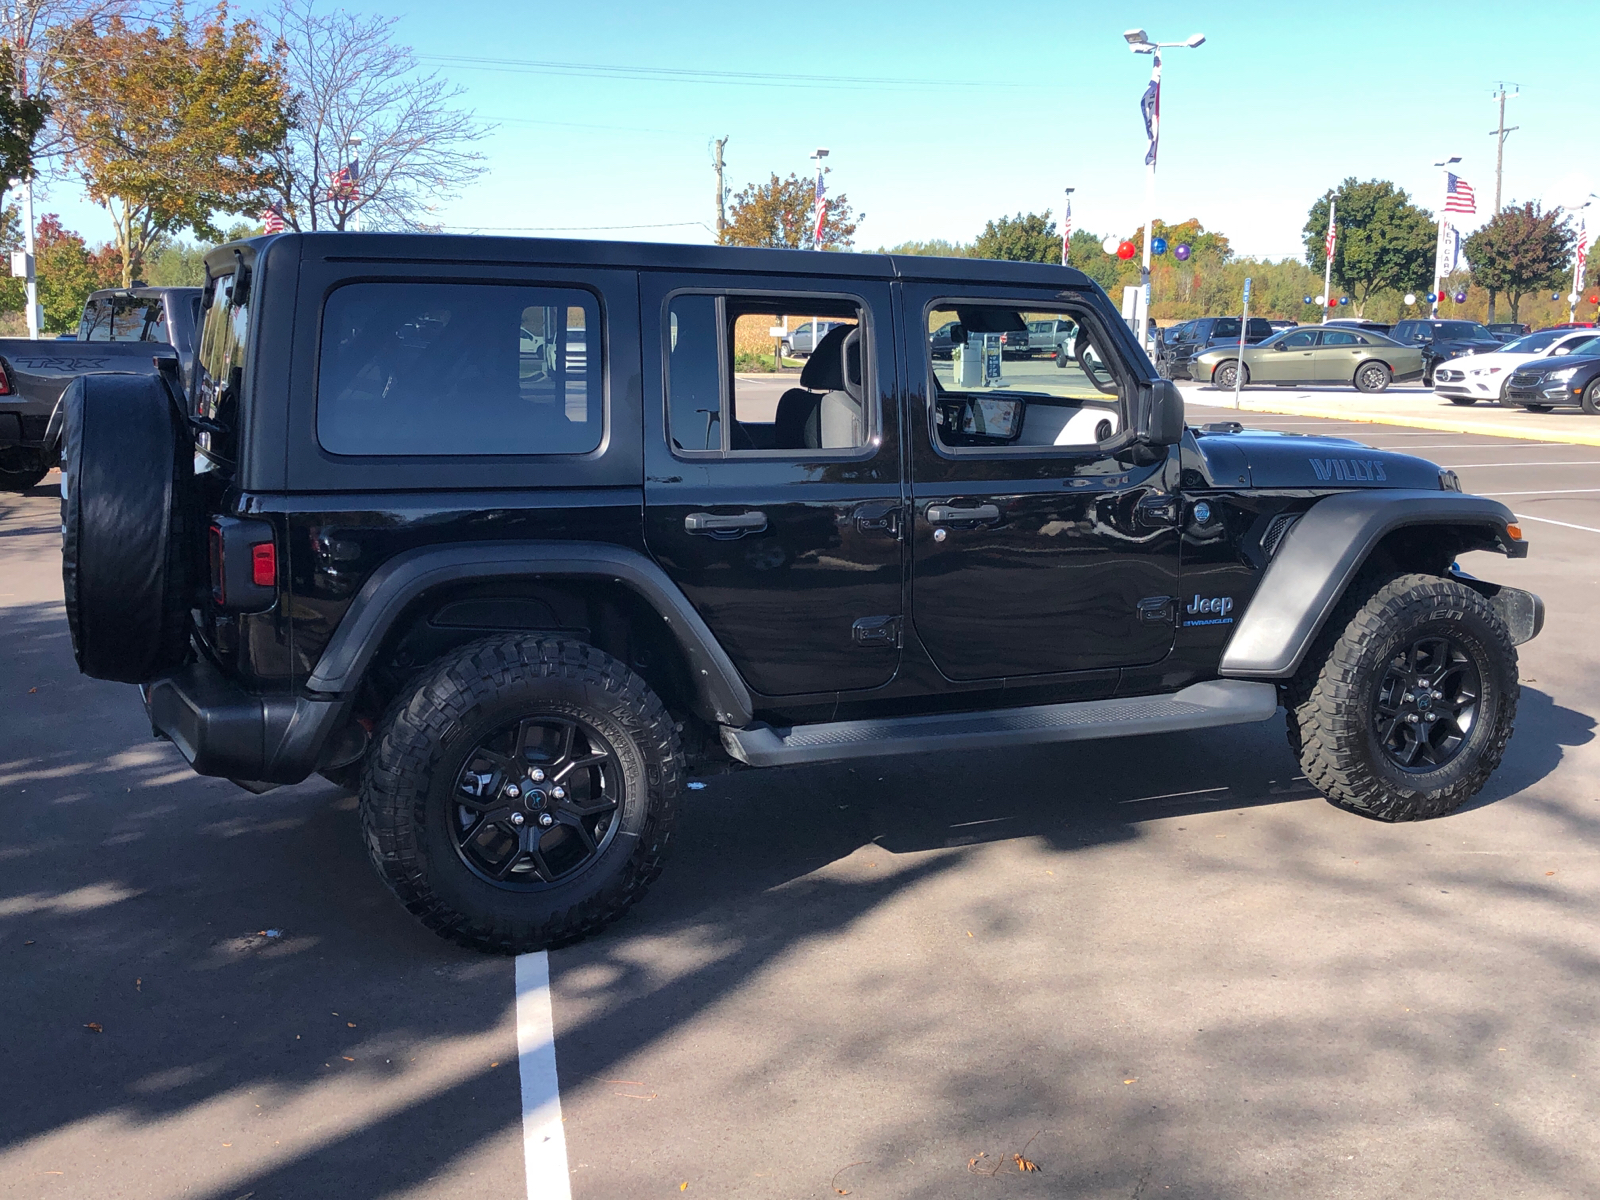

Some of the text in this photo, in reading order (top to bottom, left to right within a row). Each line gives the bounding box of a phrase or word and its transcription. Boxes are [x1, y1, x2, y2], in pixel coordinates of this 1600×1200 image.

[15, 357, 111, 372] TRX
[1308, 458, 1387, 482] WILLYS
[1186, 594, 1234, 616] Jeep
[1190, 618, 1233, 627] WRANGLER
